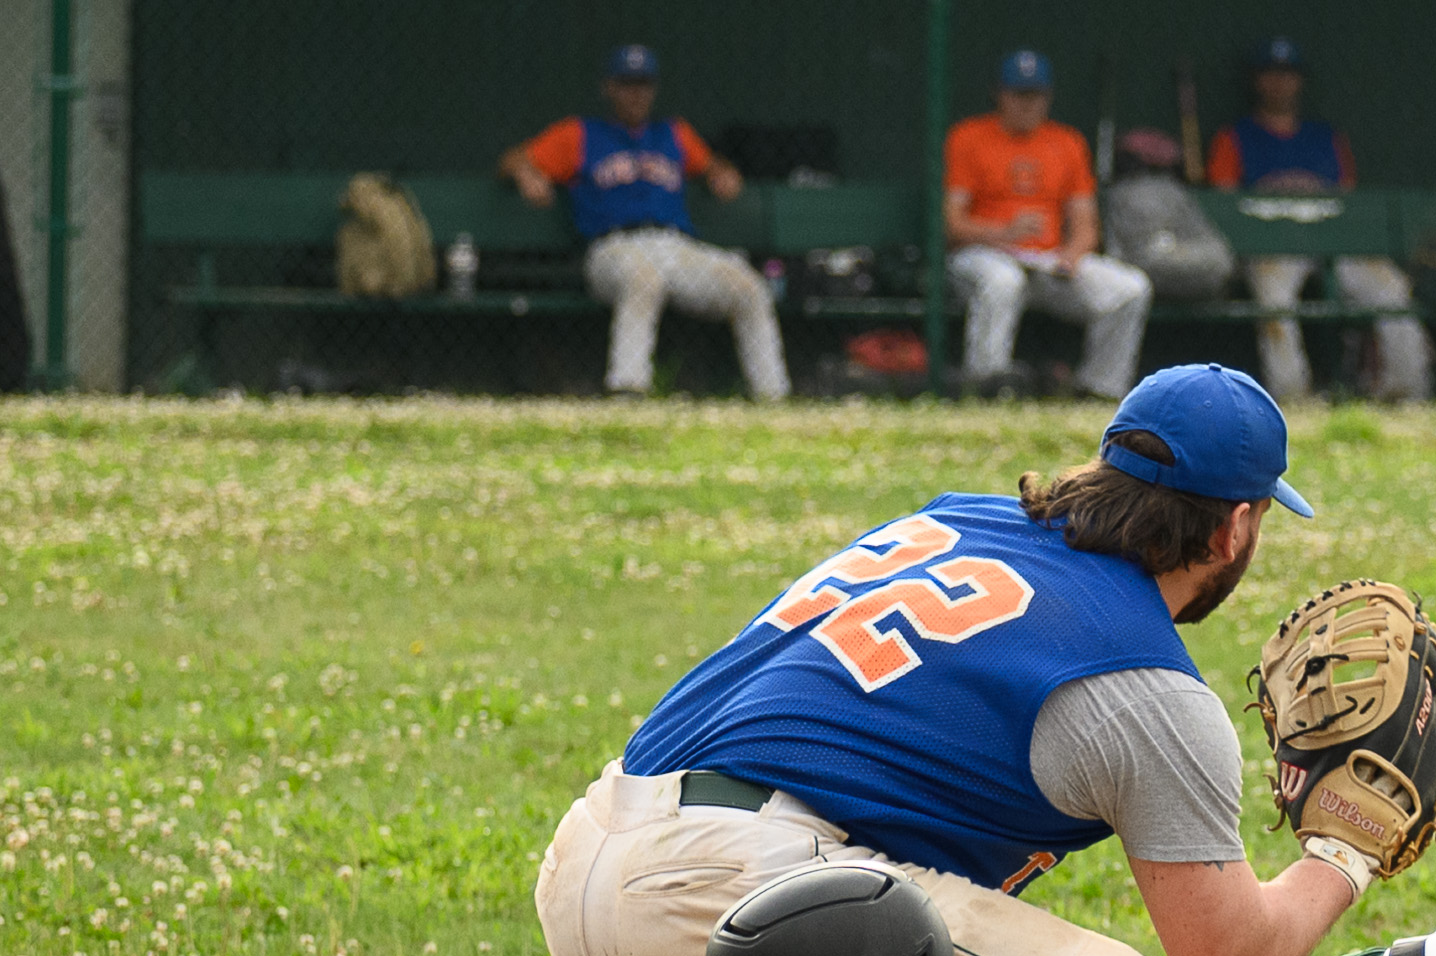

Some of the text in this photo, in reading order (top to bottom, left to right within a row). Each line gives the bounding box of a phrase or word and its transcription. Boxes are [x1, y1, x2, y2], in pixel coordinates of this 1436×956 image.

[753, 514, 1035, 693] 22
[1281, 760, 1308, 802] W
[1319, 787, 1386, 840] Wilson
